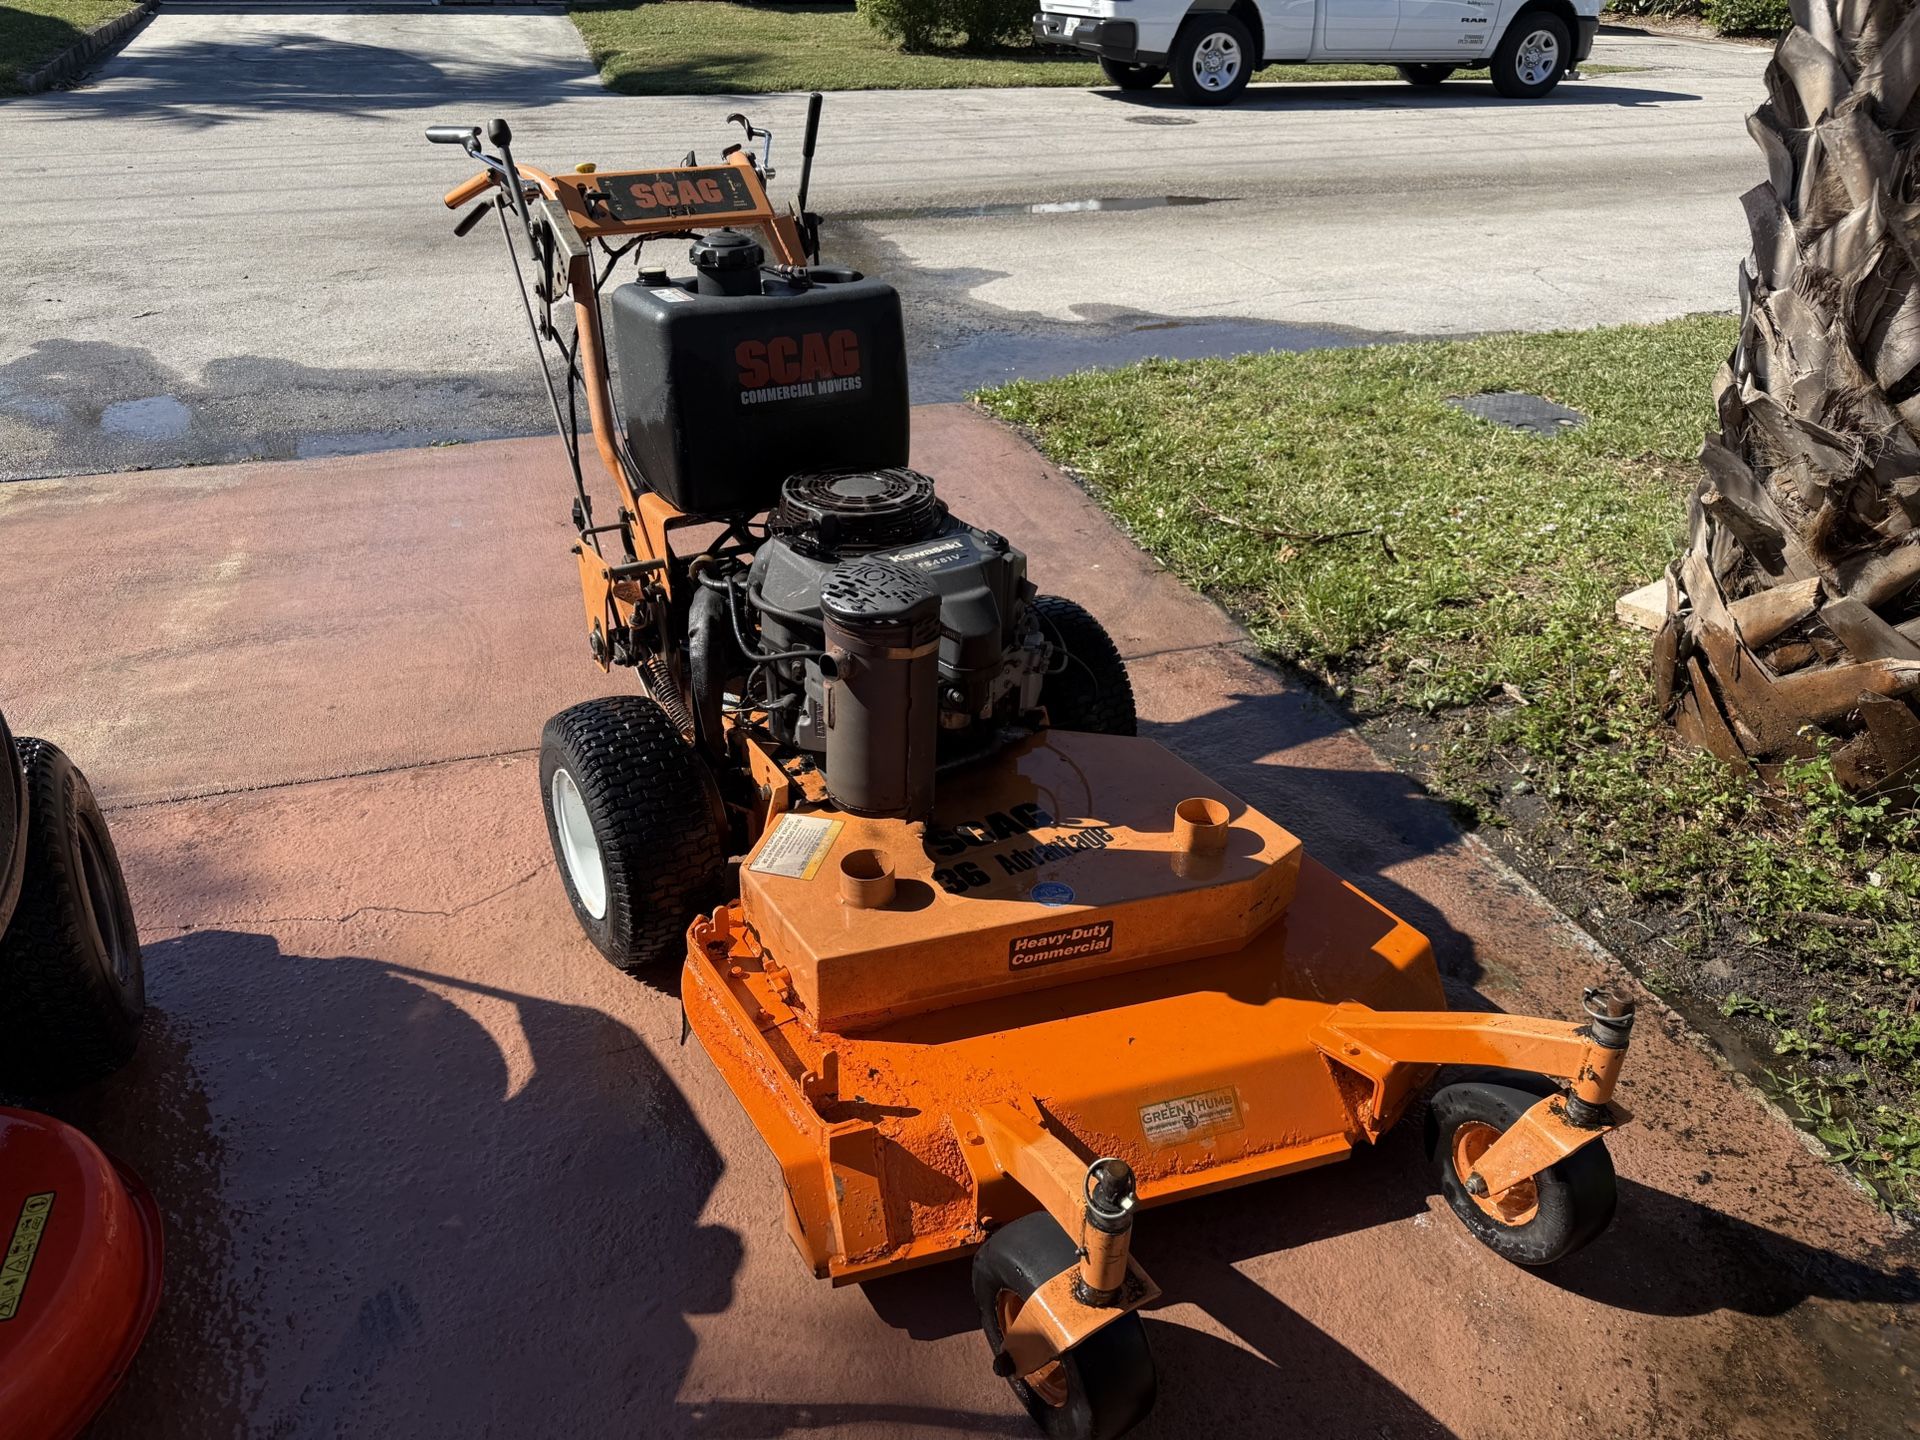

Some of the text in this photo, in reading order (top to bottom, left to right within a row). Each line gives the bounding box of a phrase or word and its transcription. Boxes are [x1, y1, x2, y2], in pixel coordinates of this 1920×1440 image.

[629, 178, 724, 209] SCAG
[735, 329, 860, 389] SCAG
[740, 376, 863, 405] COMMERCIAL MOWERS
[888, 539, 964, 563] Kawasaki
[926, 802, 1054, 857] SCAG
[932, 861, 992, 895] 36
[994, 827, 1115, 876] Advantage
[1011, 937, 1111, 966] Commercial
[1014, 925, 1110, 951] Heavy-Duty
[1142, 1103, 1186, 1125] GREEN
[1186, 1095, 1233, 1114] THUMB
